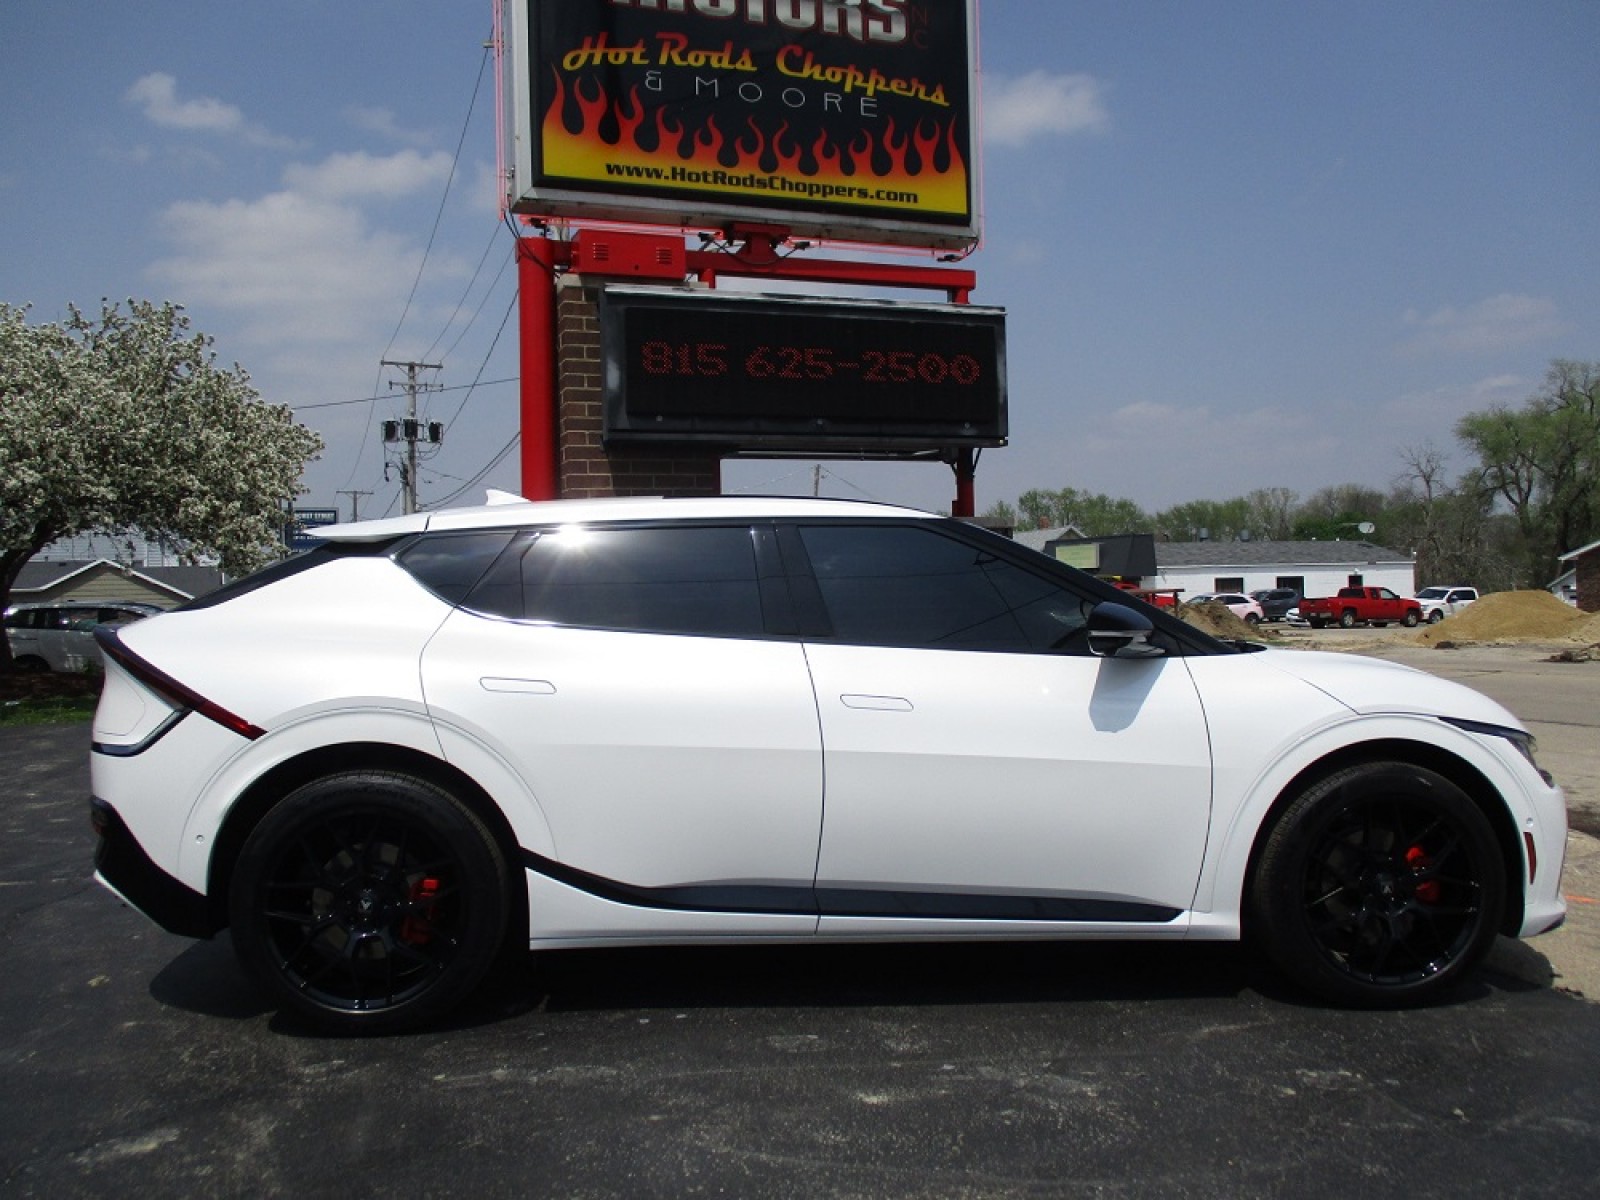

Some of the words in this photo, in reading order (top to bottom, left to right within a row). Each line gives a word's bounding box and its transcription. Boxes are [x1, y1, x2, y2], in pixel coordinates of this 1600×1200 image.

[562, 31, 649, 71] Hot
[655, 31, 758, 72] Rods
[775, 44, 950, 107] Choppers
[645, 70, 662, 91] &
[695, 76, 878, 117] MOORE
[605, 162, 918, 204] www.HotRodsChoppers.com
[641, 341, 728, 375] 815
[744, 346, 981, 385] 625-2500
